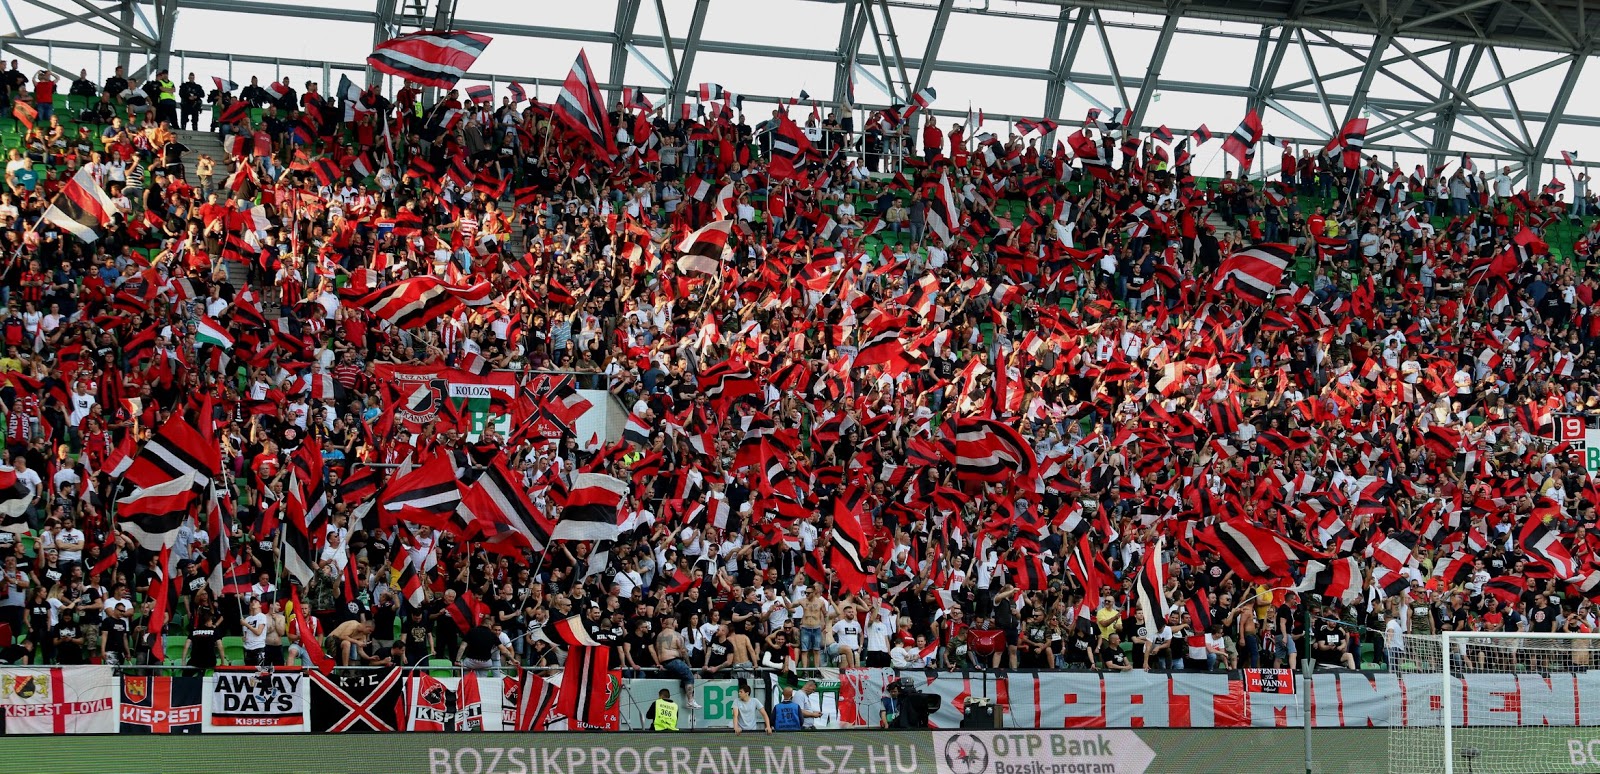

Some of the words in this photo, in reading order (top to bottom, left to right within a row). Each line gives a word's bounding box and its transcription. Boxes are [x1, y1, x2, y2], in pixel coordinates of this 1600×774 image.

[1567, 418, 1580, 437] 9
[214, 675, 302, 693] AWAY
[1252, 679, 1287, 687] HAVANNA
[4, 703, 61, 717] KISPEST
[71, 702, 111, 715] LOYAL
[223, 694, 293, 711] DAYS
[122, 707, 200, 723] KISPEST
[993, 734, 1042, 757] OTP
[1051, 734, 1113, 757] Bank
[428, 745, 917, 774] BOZSIKPROGRAM.MLSZ.HU
[995, 760, 1115, 774] Bozsik-program
